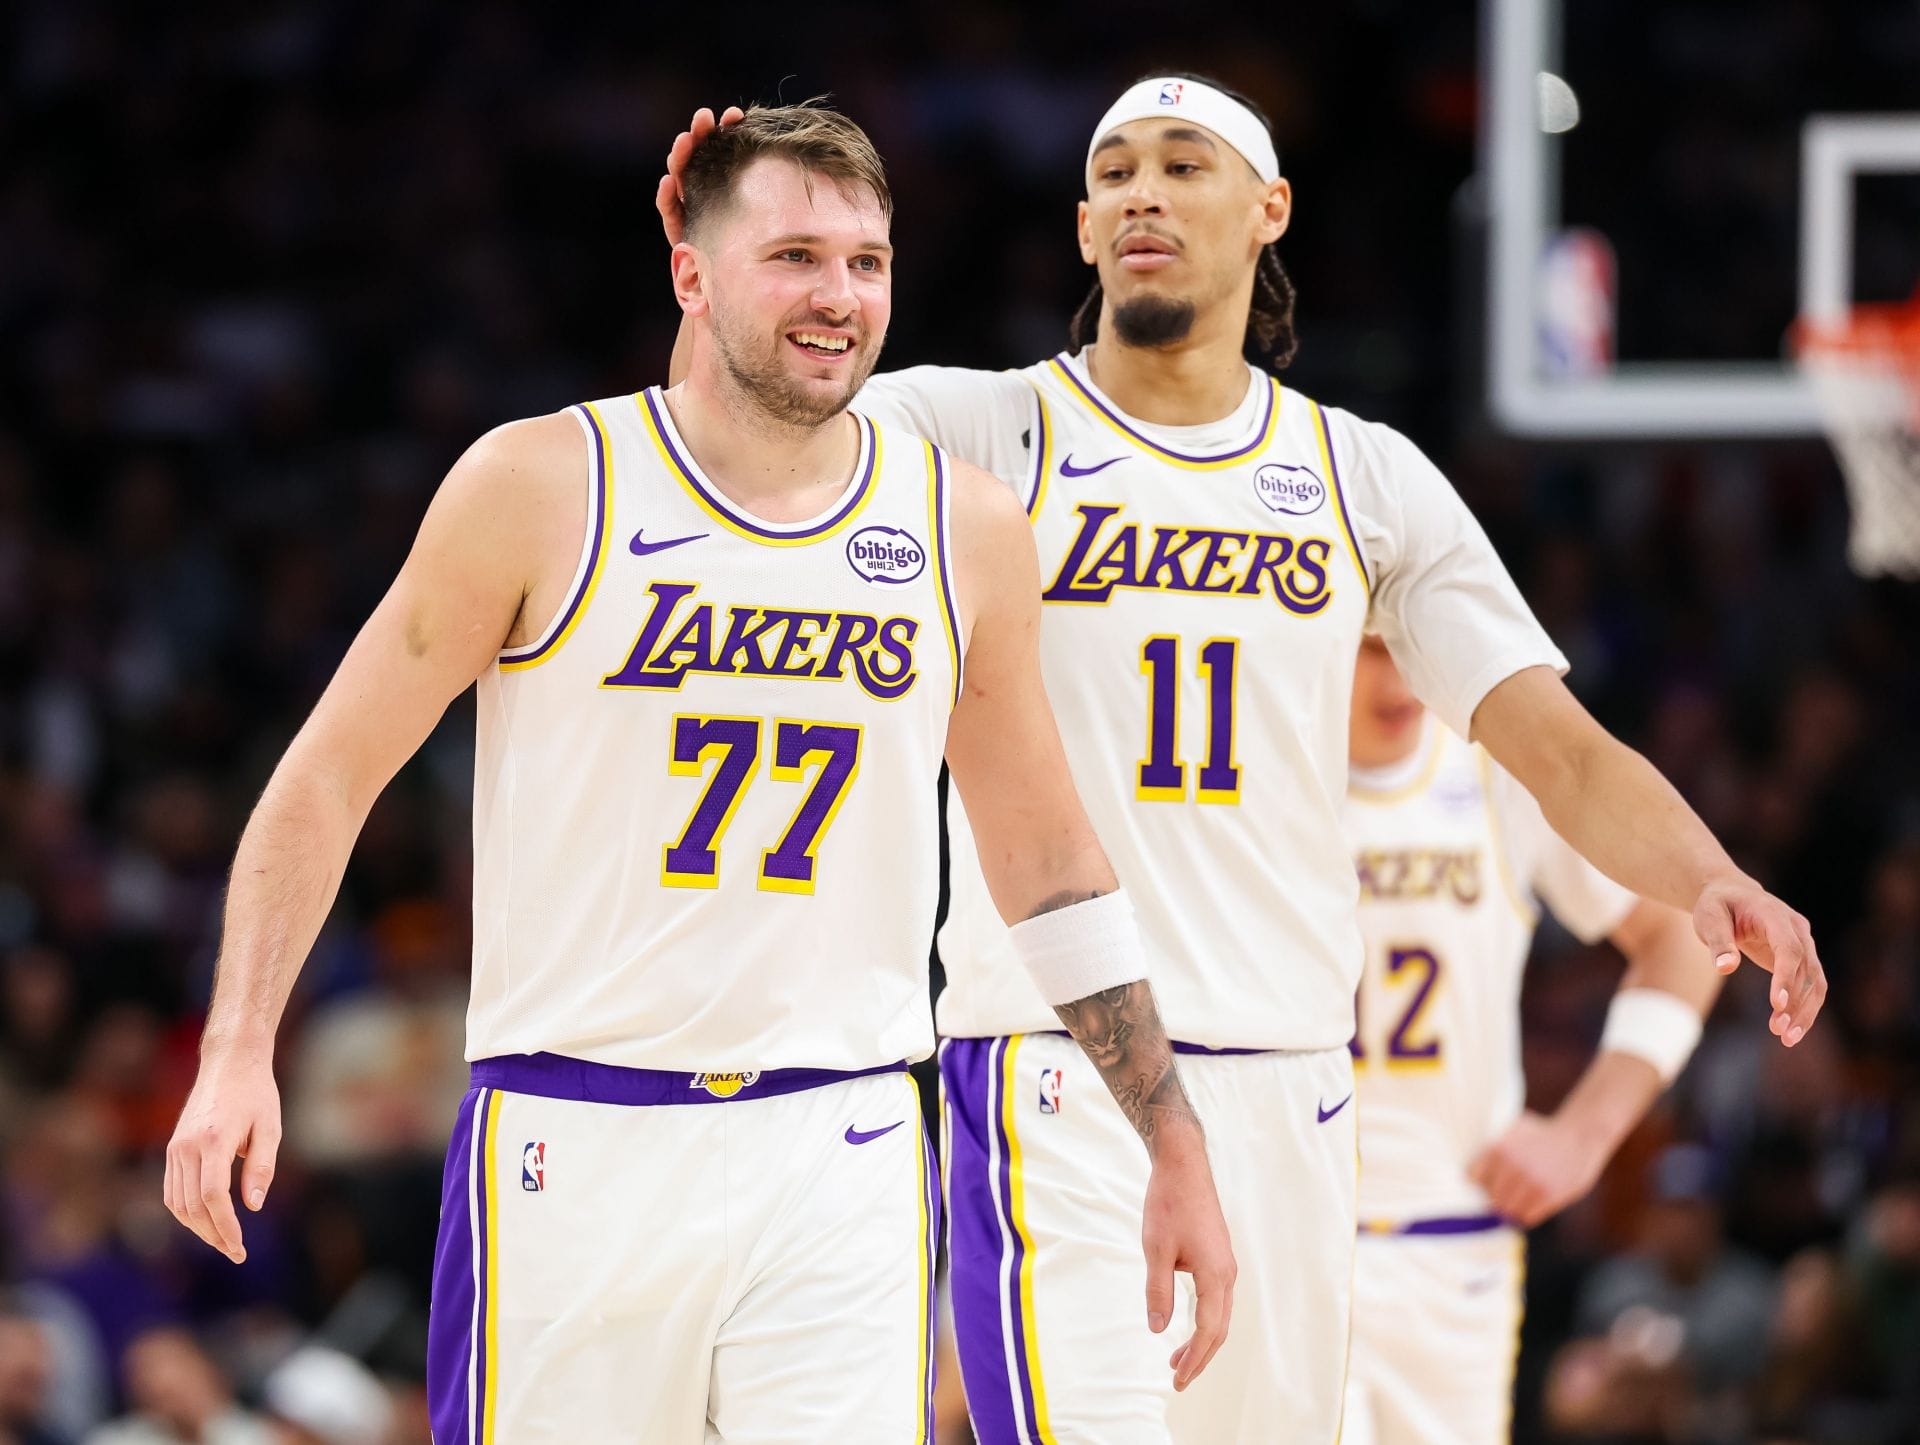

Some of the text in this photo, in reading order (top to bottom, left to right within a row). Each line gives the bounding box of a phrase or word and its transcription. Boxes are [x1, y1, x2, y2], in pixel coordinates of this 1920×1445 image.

[1260, 475, 1320, 501] bibigo
[853, 541, 920, 568] bibigo
[867, 561, 895, 570] 비비고
[1042, 502, 1335, 618] LAKERS
[599, 579, 920, 702] LAKERS
[1136, 634, 1243, 806] 11
[660, 712, 865, 894] 77
[1358, 847, 1481, 908] KERS
[1347, 942, 1443, 1071] 2
